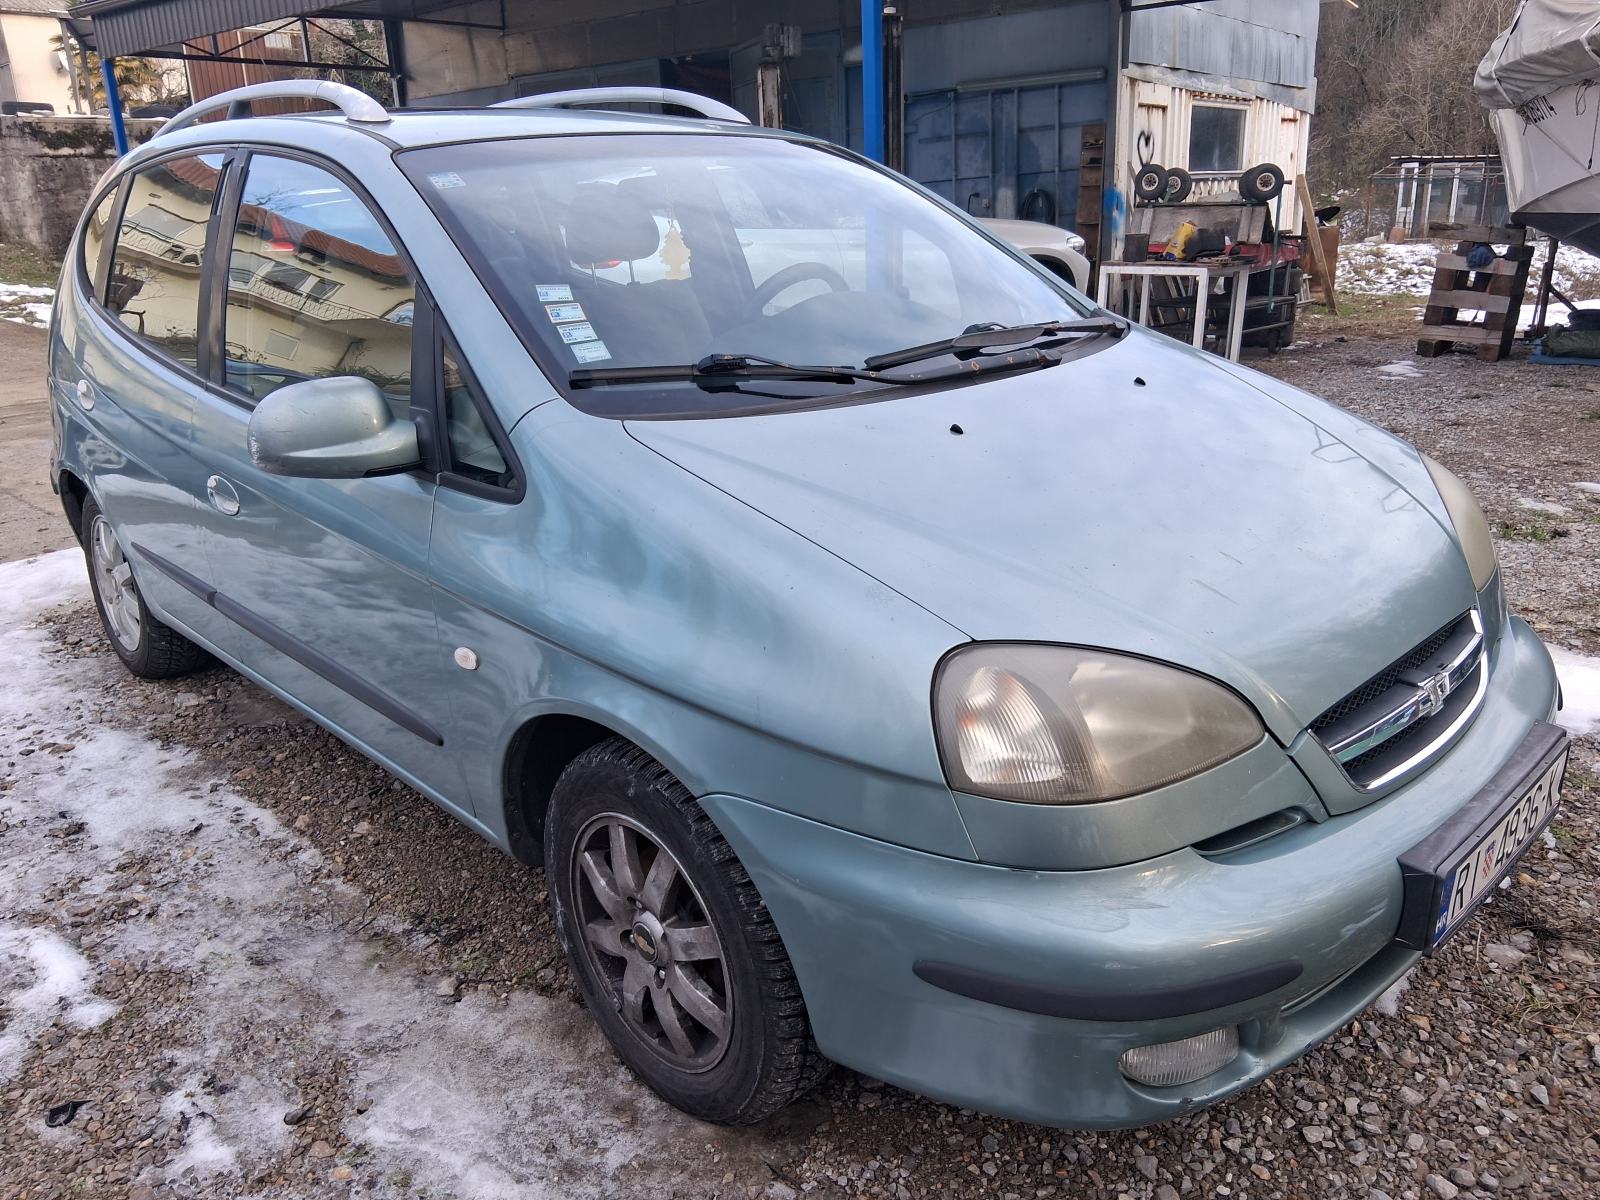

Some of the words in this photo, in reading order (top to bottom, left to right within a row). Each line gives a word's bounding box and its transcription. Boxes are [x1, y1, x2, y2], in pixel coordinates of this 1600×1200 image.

[1451, 850, 1481, 919] RI
[1494, 762, 1560, 869] 4936-K
[1435, 911, 1448, 934] HR
